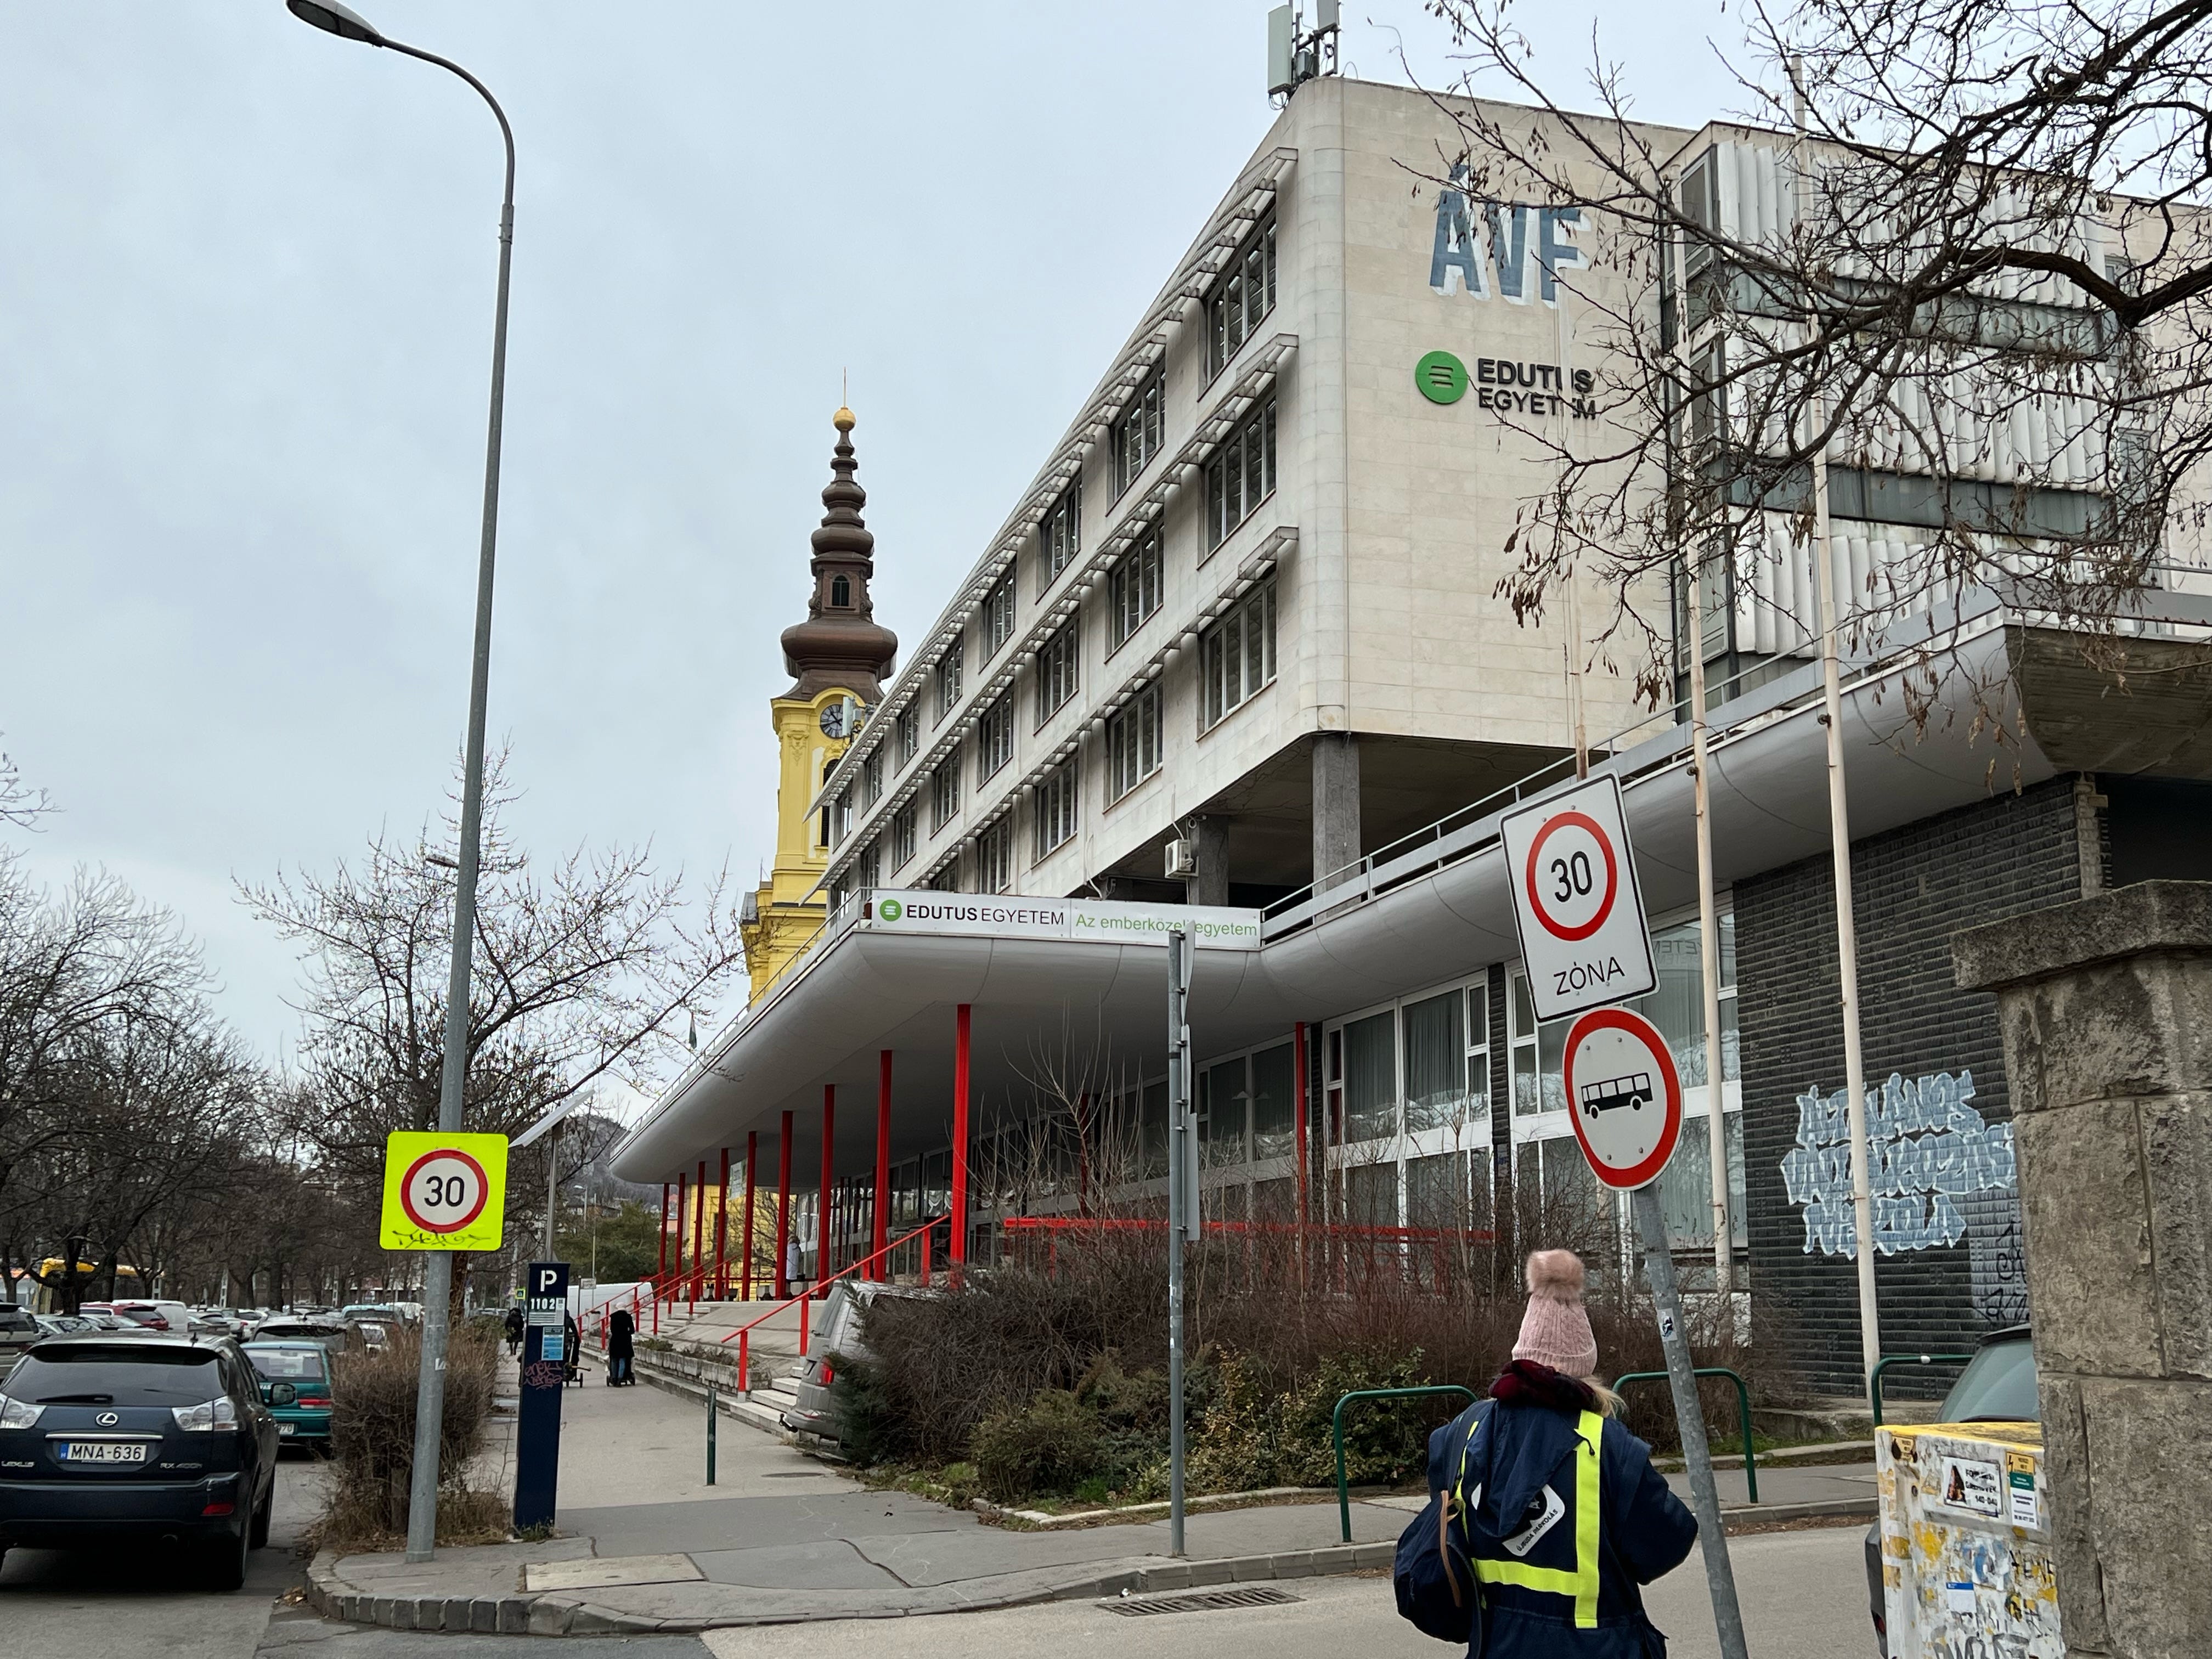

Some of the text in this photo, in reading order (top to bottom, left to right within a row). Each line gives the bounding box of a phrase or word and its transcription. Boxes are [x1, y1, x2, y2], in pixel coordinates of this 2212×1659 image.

[1479, 387, 1596, 420] EGYETM
[1551, 851, 1593, 902] 30
[906, 905, 1064, 925] EDUTUS EGYETEM
[1075, 913, 1096, 928] Az
[1194, 923, 1257, 938] egyetem
[1553, 956, 1626, 996] ZÓNA
[424, 1176, 465, 1207] 30
[540, 1269, 557, 1292] P
[531, 1297, 556, 1310] 1102
[71, 1444, 142, 1459] MNA-636
